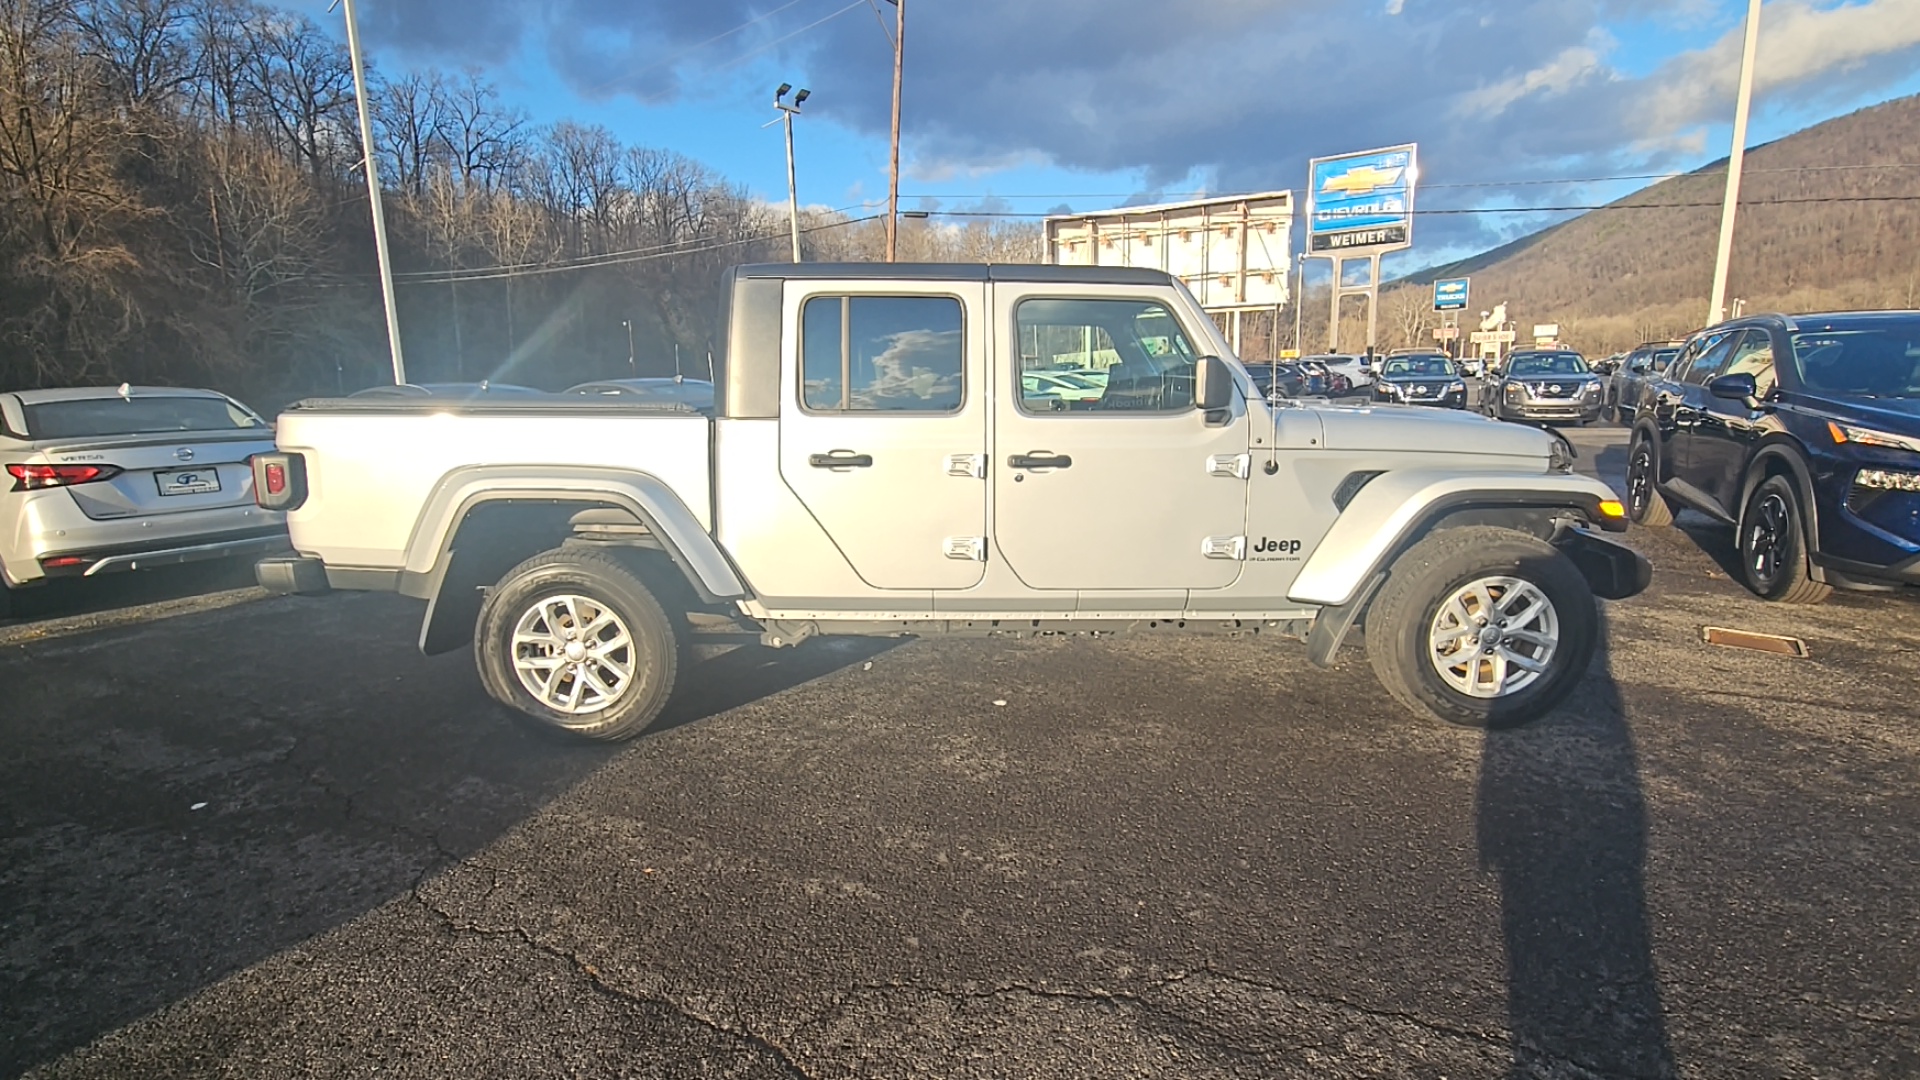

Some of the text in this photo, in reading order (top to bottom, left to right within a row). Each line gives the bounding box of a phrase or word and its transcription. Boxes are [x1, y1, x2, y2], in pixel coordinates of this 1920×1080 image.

[1318, 199, 1405, 221] CHEVROL
[1330, 231, 1386, 247] WEIMER
[60, 453, 105, 462] VERSA
[1254, 537, 1302, 555] Jeep
